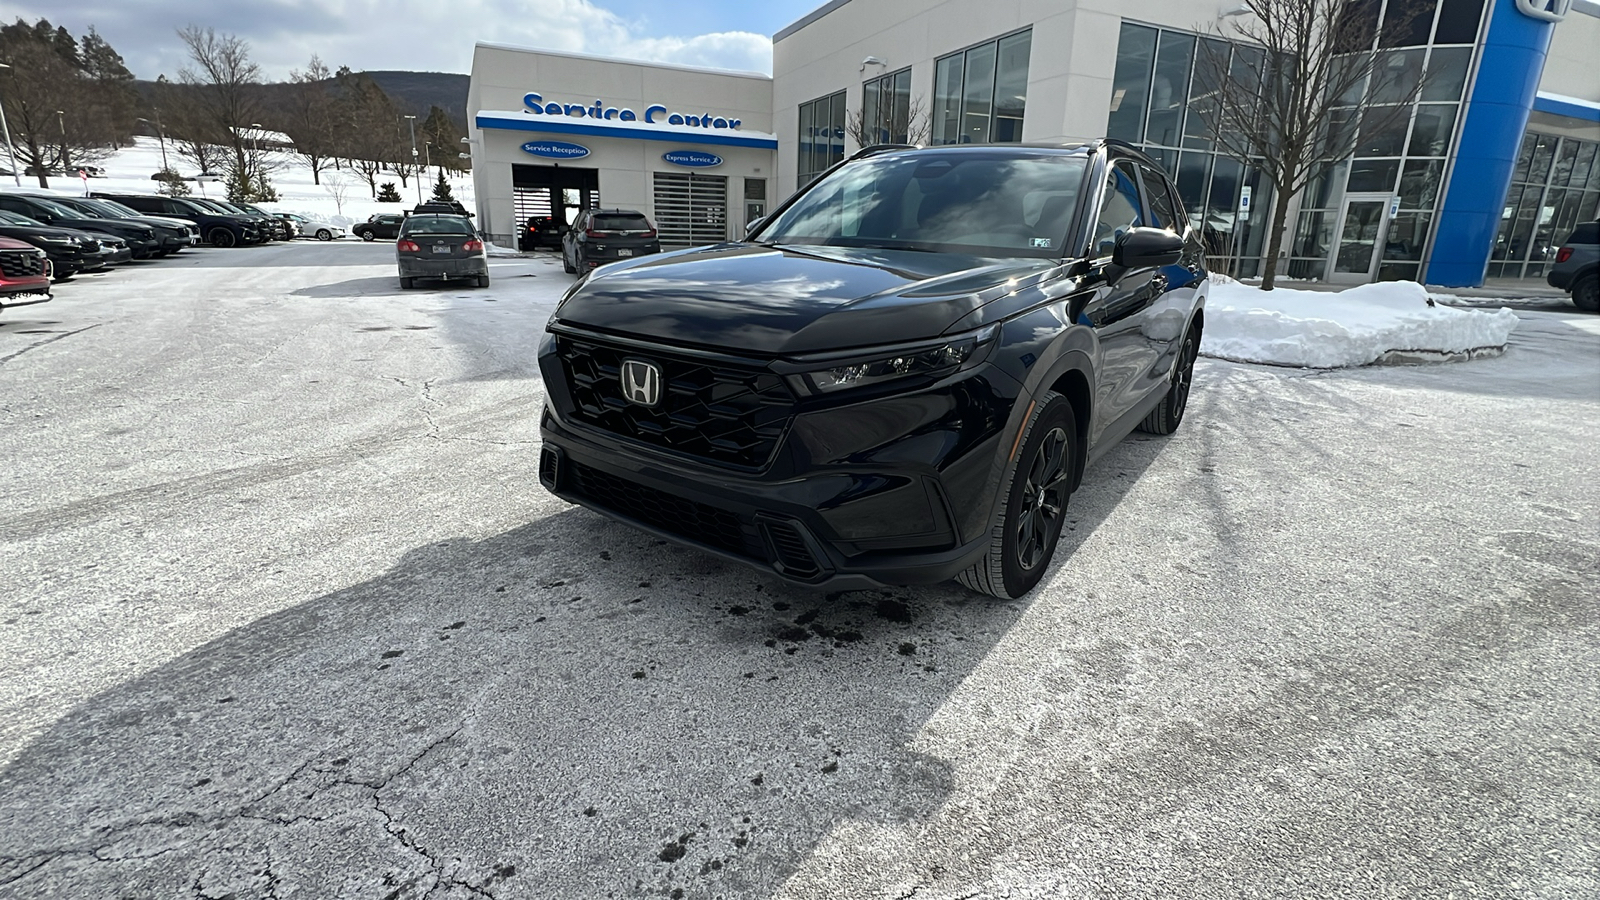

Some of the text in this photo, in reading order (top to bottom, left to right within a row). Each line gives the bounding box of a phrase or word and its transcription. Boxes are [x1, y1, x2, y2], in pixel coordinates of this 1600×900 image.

[523, 92, 742, 130] Service Center
[525, 144, 586, 156] Service Reception
[666, 154, 711, 163] Express Service
